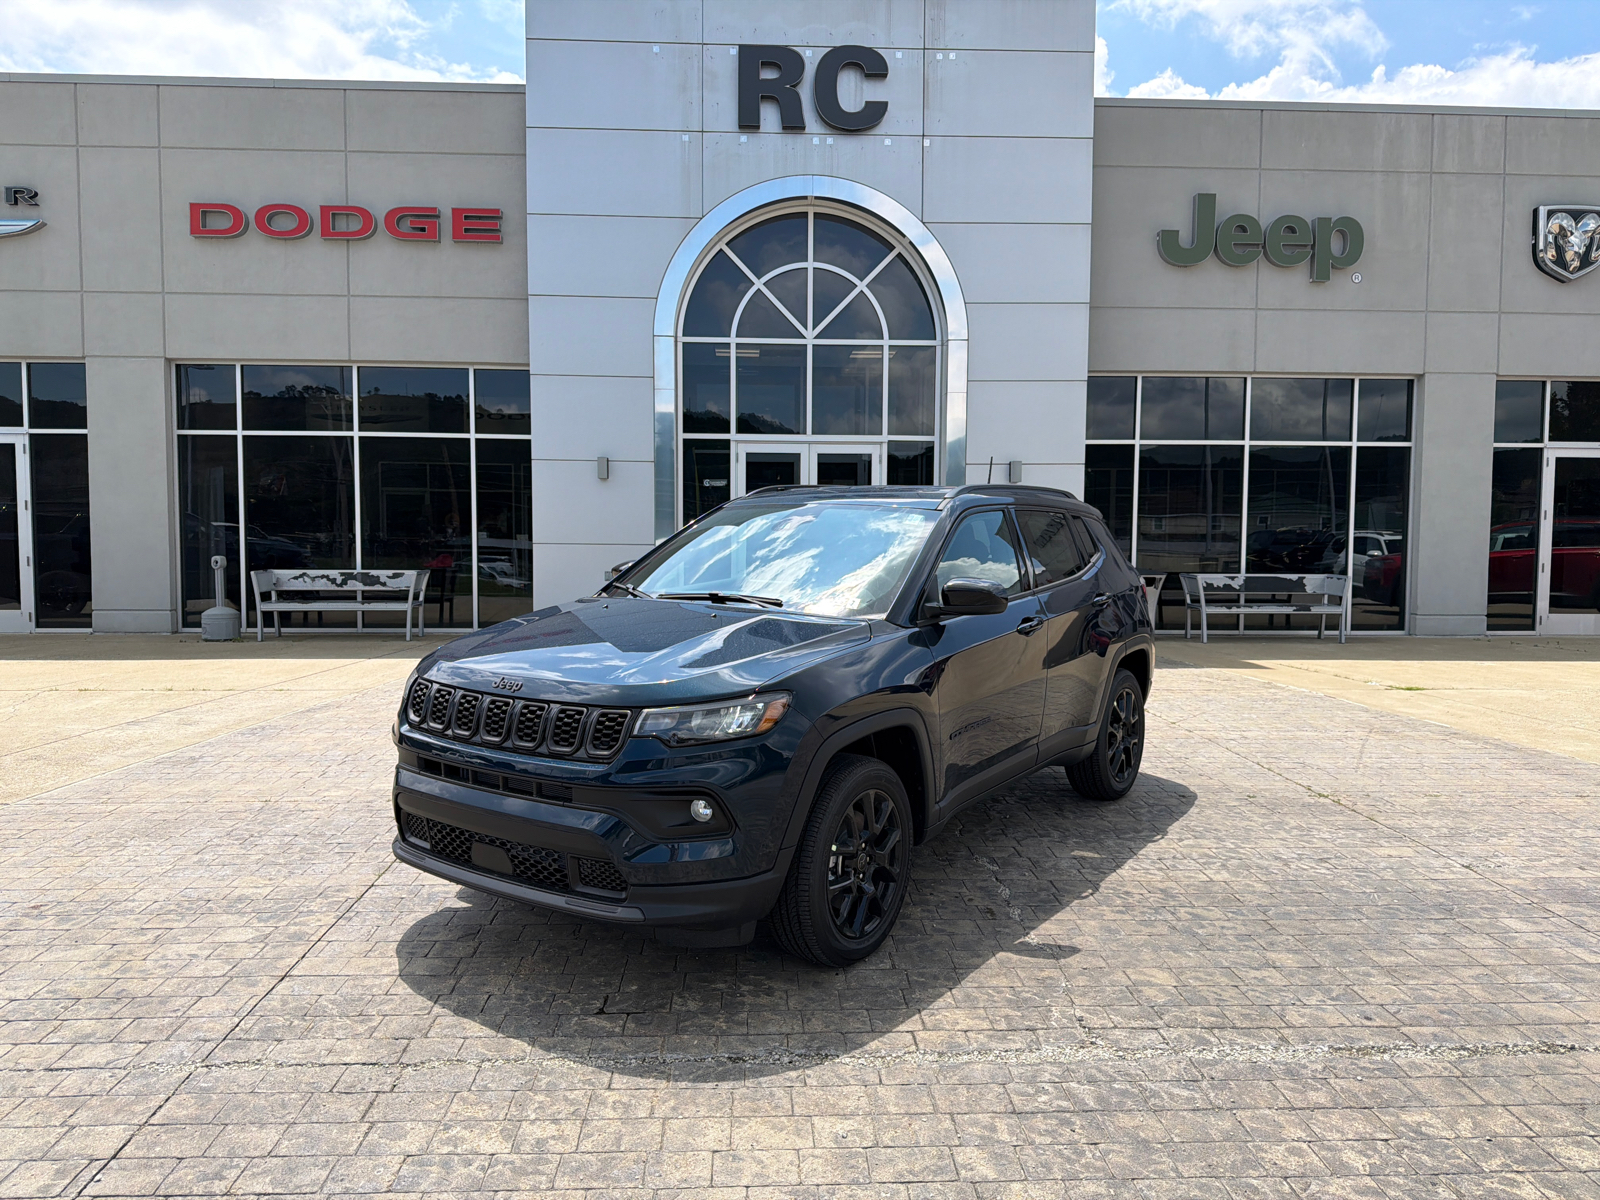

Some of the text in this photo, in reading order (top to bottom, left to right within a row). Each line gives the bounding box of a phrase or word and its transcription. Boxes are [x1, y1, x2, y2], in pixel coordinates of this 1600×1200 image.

[738, 44, 889, 132] RC
[189, 202, 503, 244] DODGE
[1156, 193, 1364, 283] Jeep
[492, 676, 523, 693] Jeep
